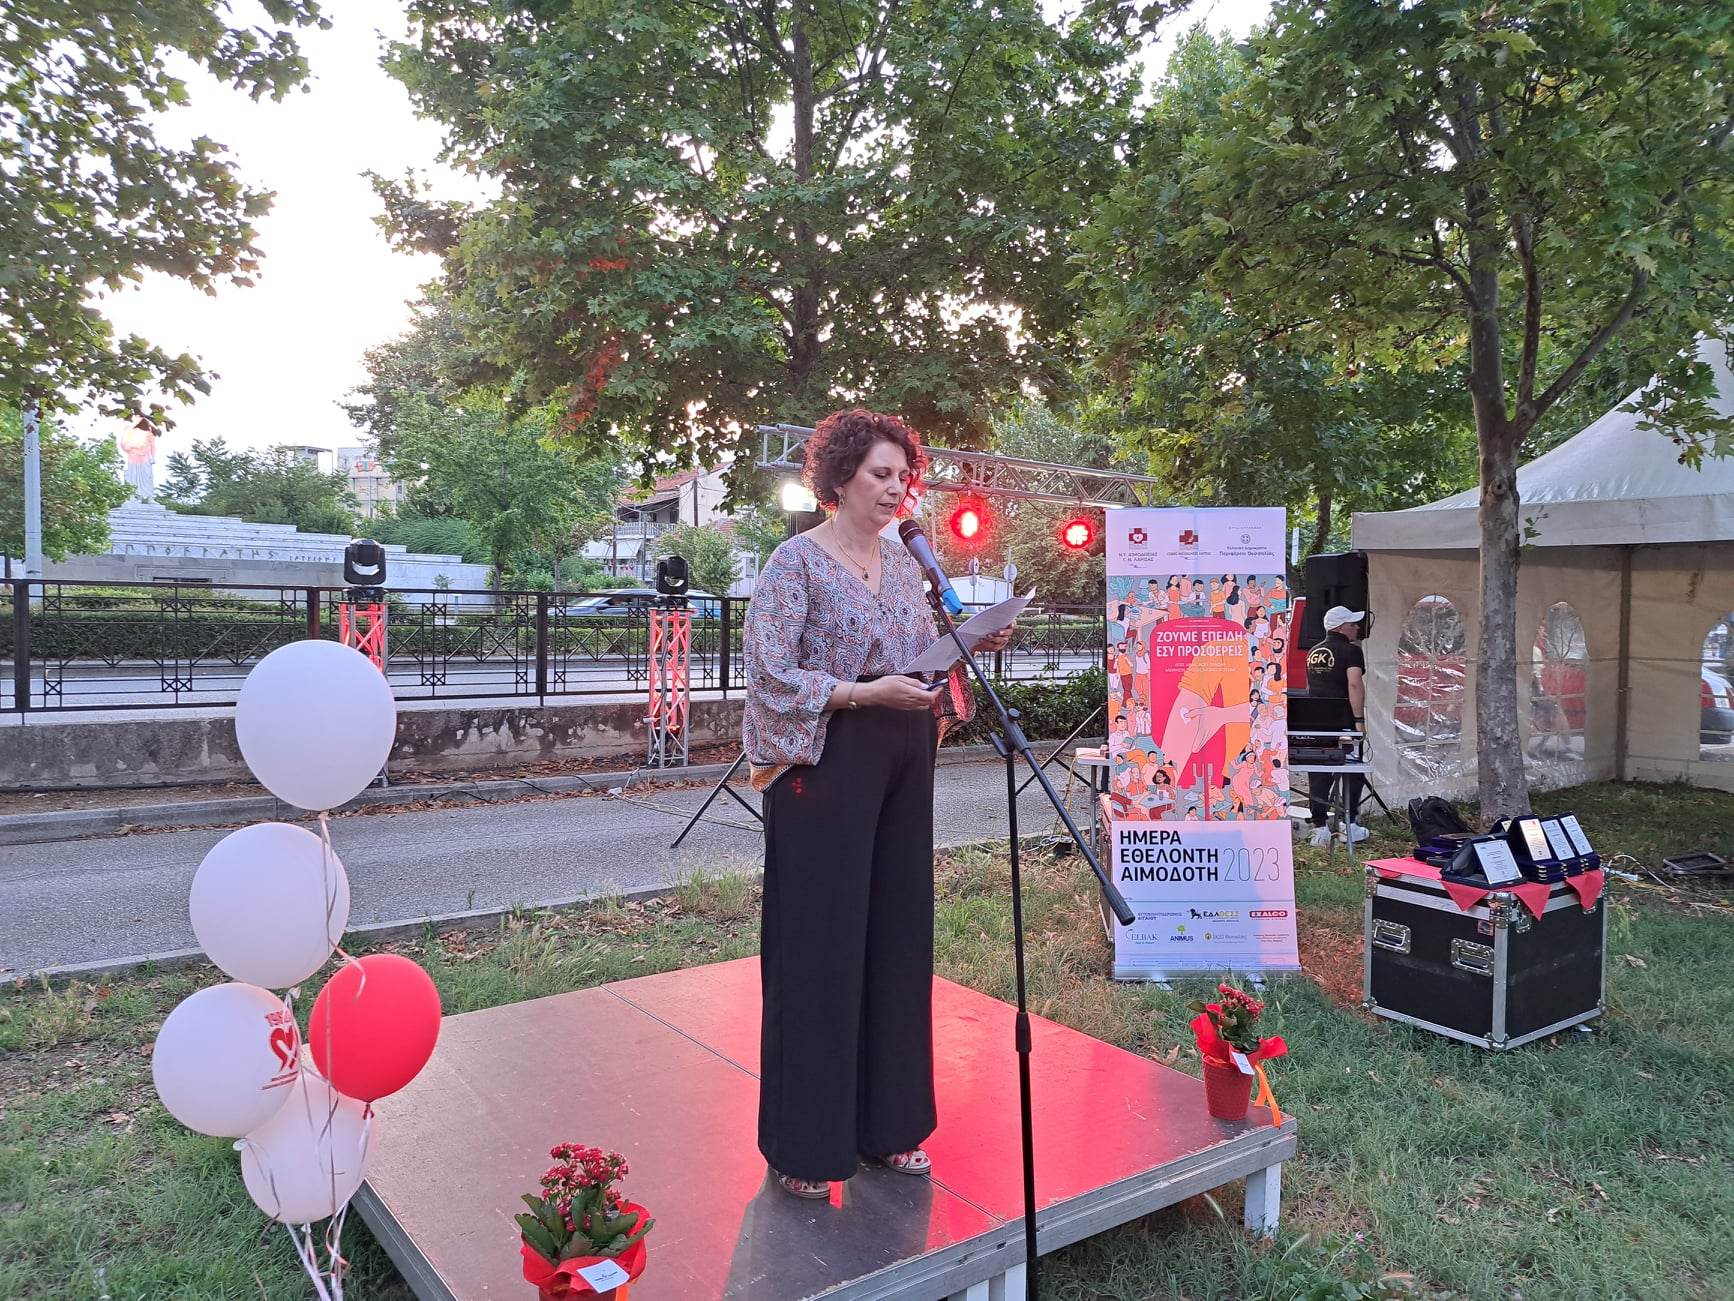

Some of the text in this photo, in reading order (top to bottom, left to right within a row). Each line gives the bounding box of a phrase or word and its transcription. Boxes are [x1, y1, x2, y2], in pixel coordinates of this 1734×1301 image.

[1156, 630, 1243, 642] ΖΟΥΜΕ ΕΠΕΙΔΗ
[1156, 645, 1243, 657] ΕΣΥ ΠΡΟΣΦΕΡΕΙΣ
[1310, 653, 1328, 664] GK
[1120, 830, 1182, 845] ΗΜΕΡΑ
[1121, 848, 1218, 864] ΕΘΕΛΟΝΤΗ
[1223, 847, 1280, 882] 2023
[1121, 866, 1218, 882] ΑΙΜΟΔΟΤΗ
